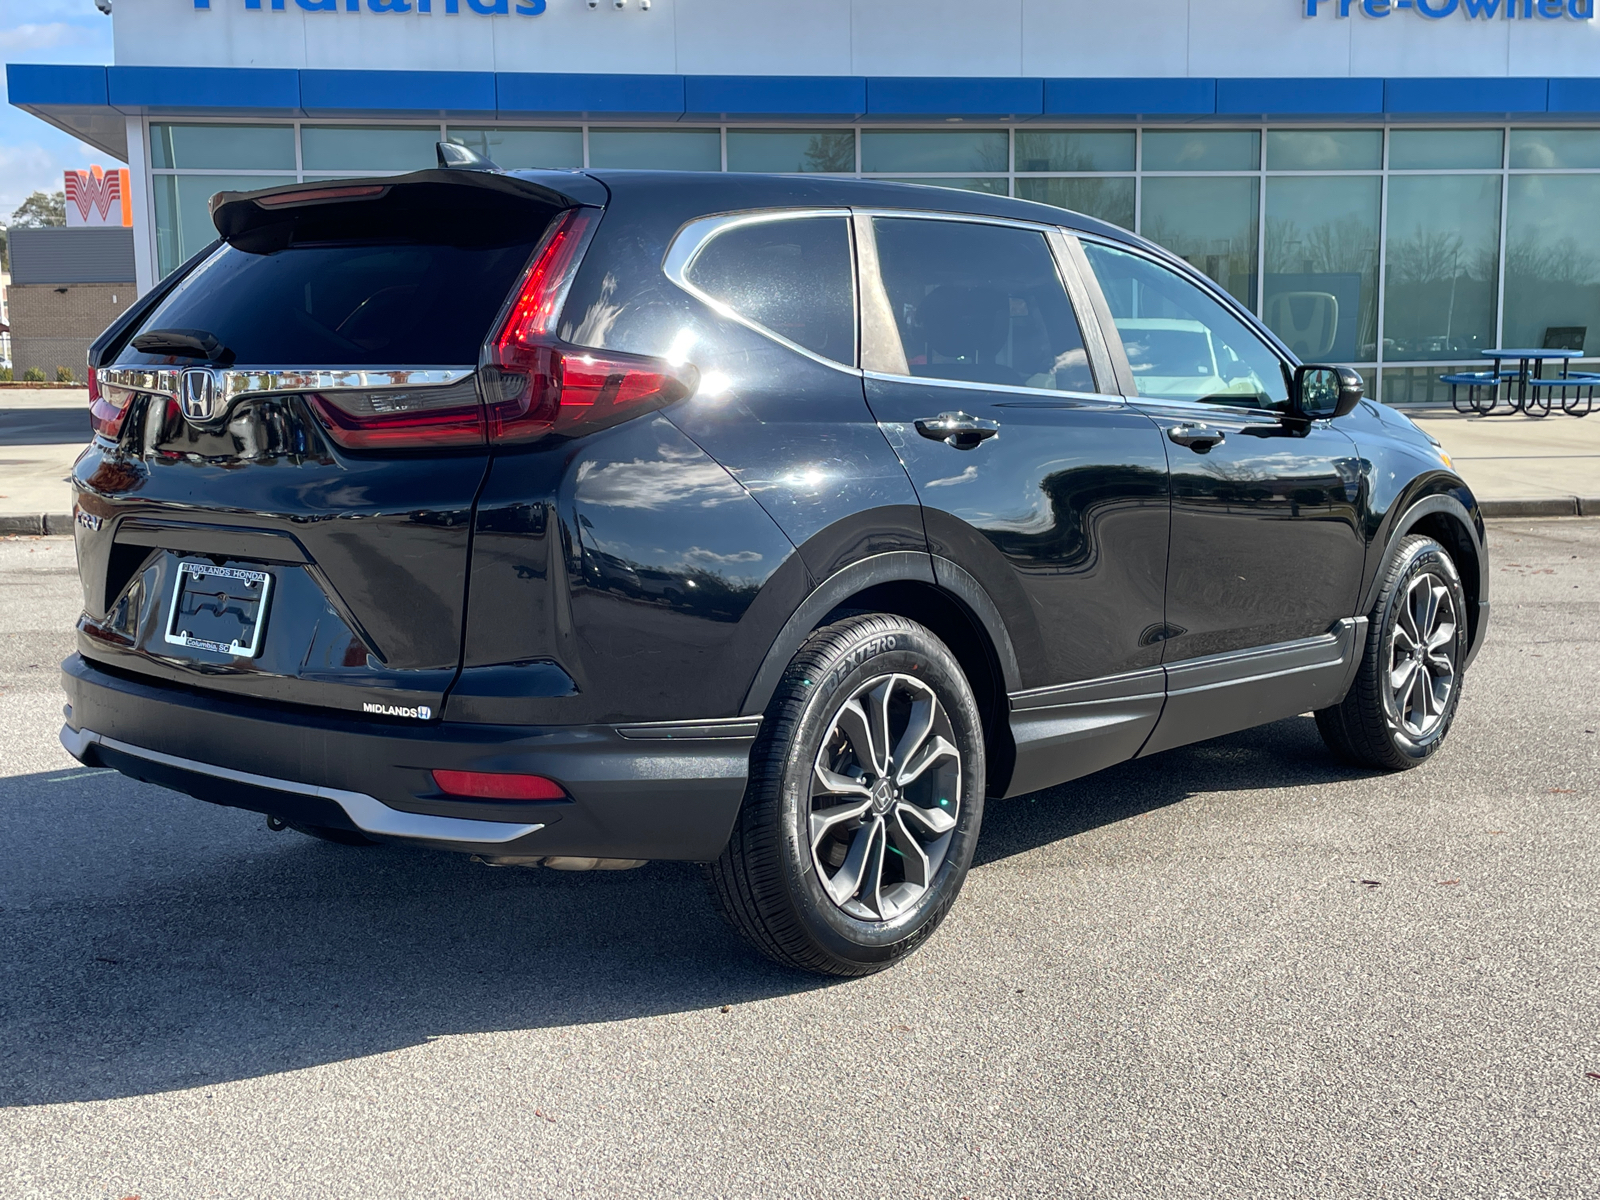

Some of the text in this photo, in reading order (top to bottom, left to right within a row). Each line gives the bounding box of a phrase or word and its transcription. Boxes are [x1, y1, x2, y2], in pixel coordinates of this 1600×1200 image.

[194, 0, 547, 16] dands
[188, 564, 264, 581] MIDLANDS HONDA
[218, 644, 230, 653] SC
[363, 702, 418, 718] MIDLANDS
